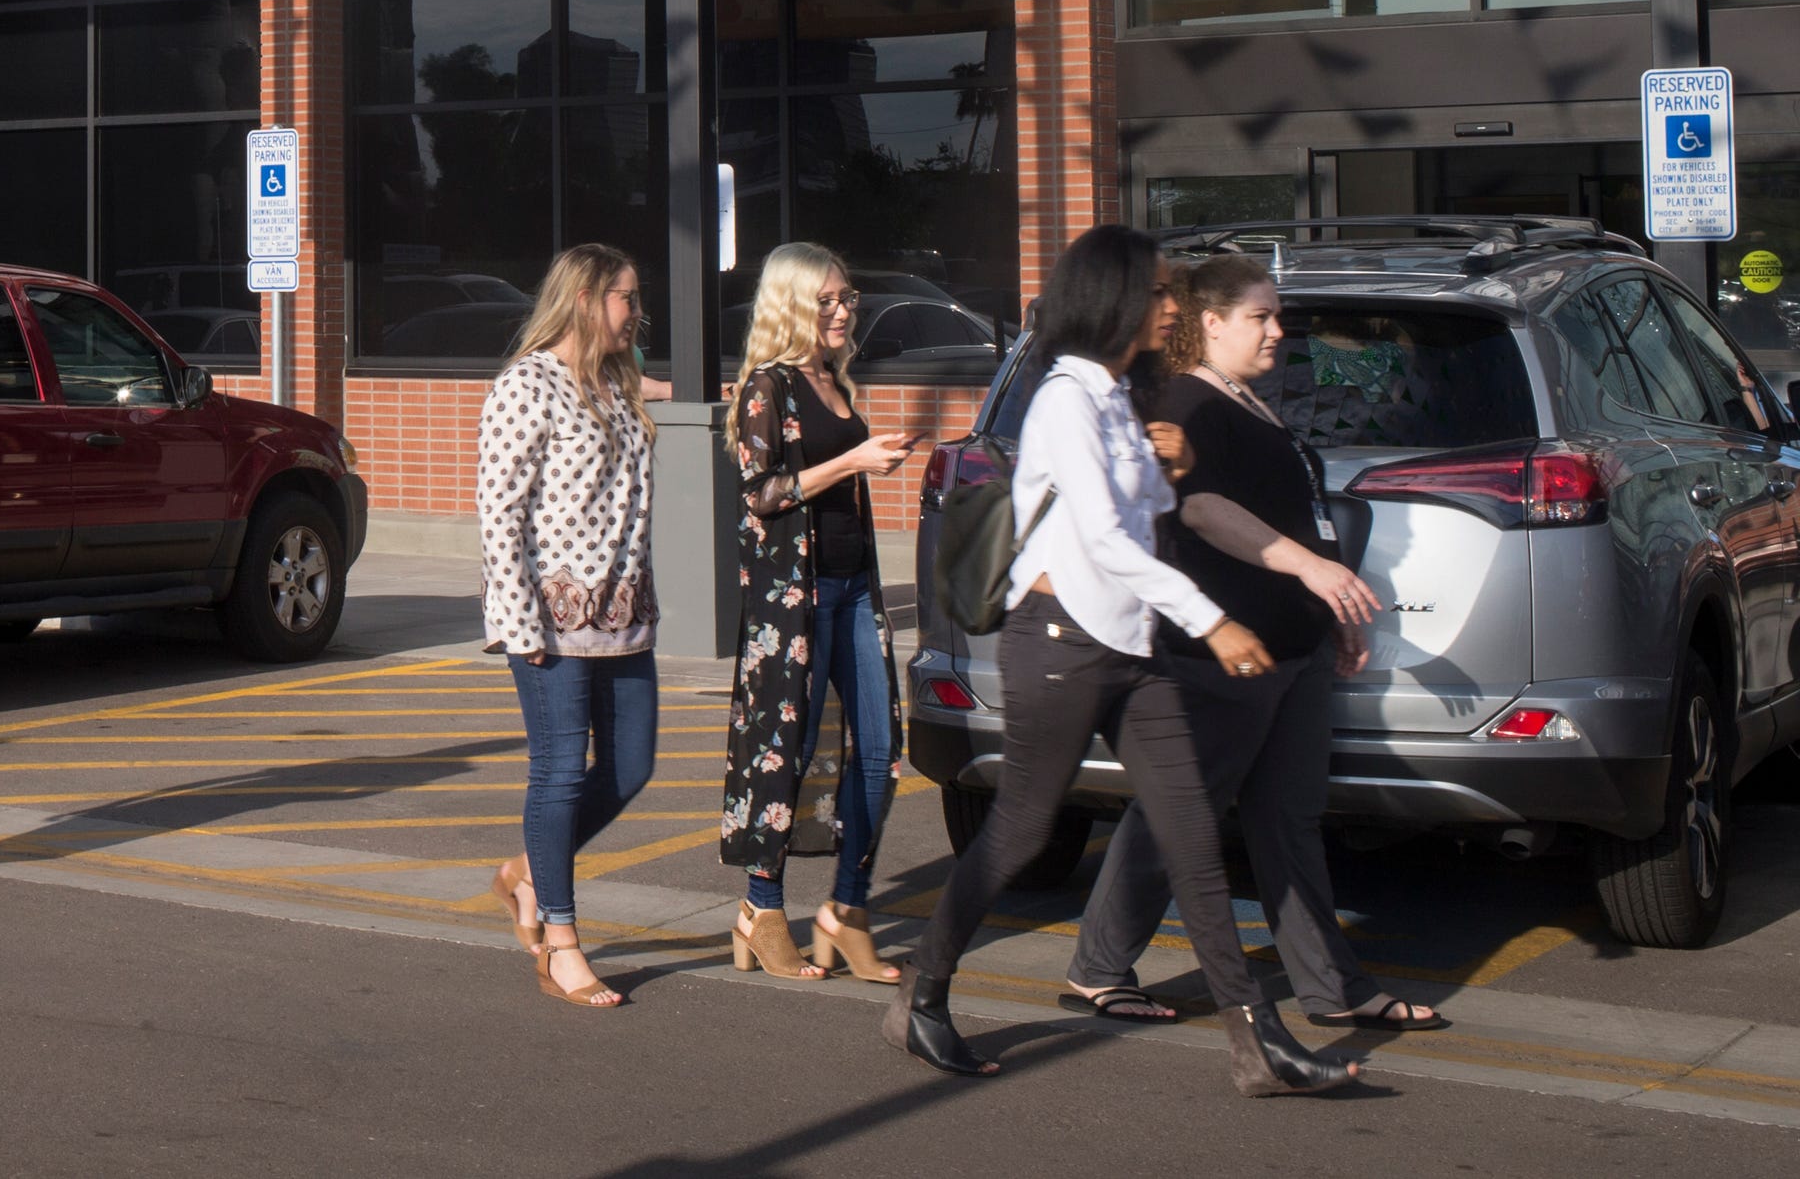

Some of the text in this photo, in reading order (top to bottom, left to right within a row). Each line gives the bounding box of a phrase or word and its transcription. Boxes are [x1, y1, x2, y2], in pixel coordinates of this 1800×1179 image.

[1649, 75, 1724, 93] RESERVED
[1655, 94, 1720, 112] PARKING
[251, 135, 295, 148] RESERVED
[255, 150, 292, 162] PARKING
[1662, 162, 1716, 172] FOR VEHICLES
[1652, 173, 1727, 184] SHOWING DISABLED
[1652, 185, 1727, 195] INSIGNIA OR LICENSE
[1666, 197, 1714, 207] PLATE ONLY
[265, 266, 282, 276] VAN
[1741, 267, 1781, 276] CAUTION
[1390, 599, 1436, 612] XLE
